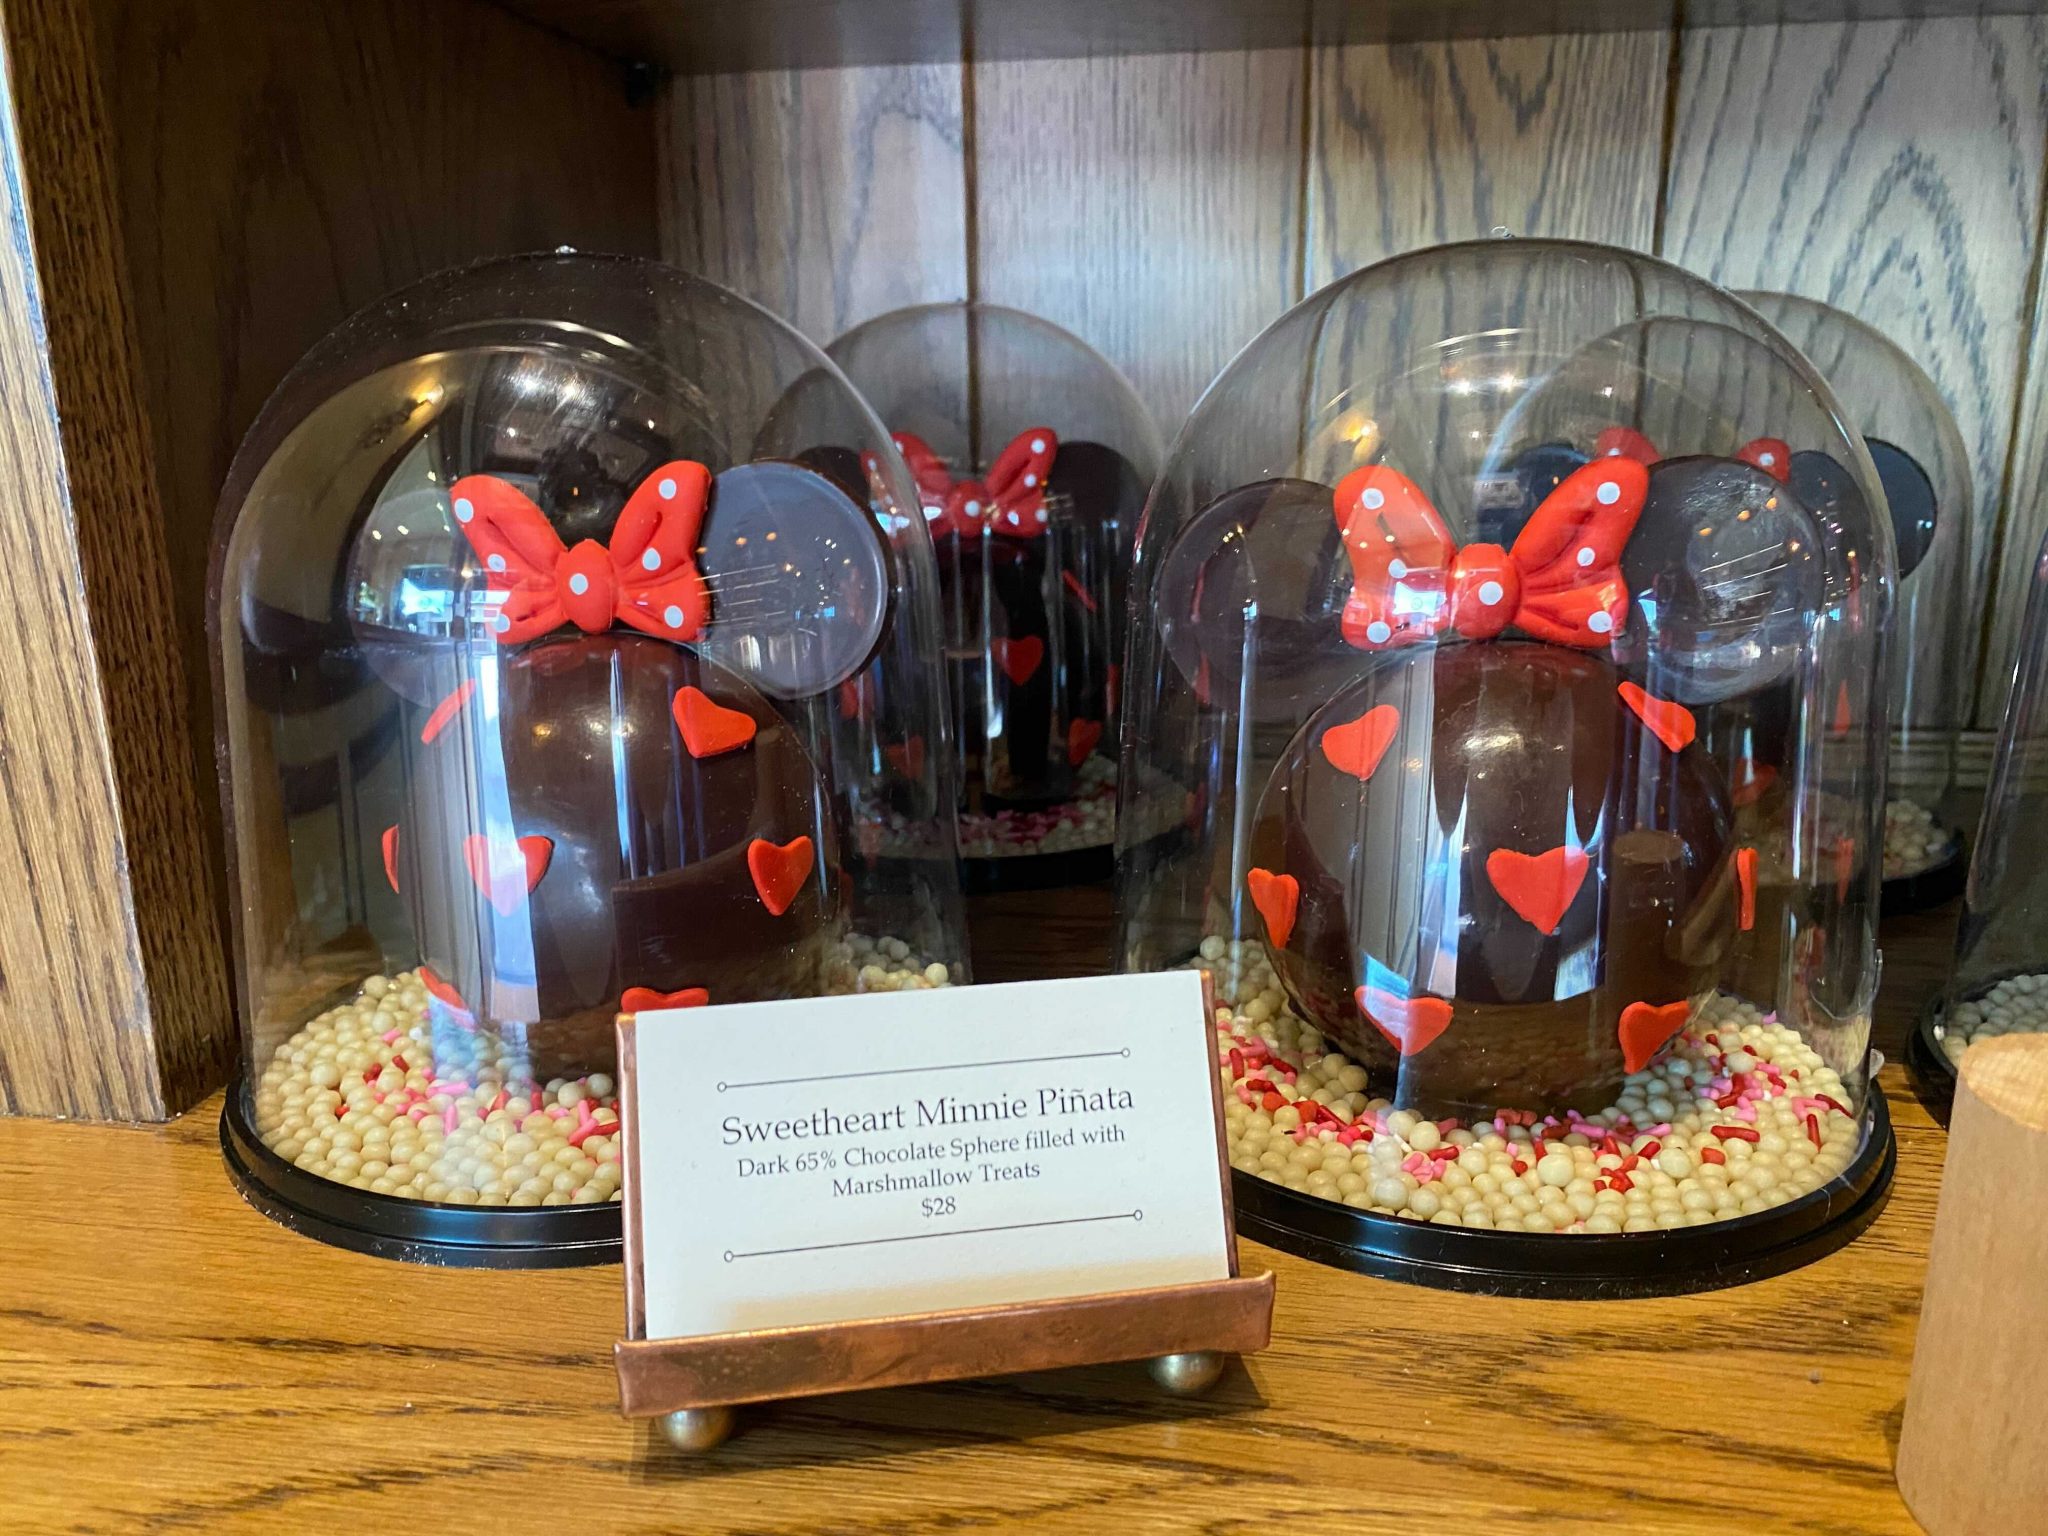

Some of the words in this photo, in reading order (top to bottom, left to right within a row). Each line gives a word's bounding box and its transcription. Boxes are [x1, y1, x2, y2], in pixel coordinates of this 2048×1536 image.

[721, 1104, 906, 1146] Sweetheart
[914, 1092, 1028, 1128] Minnie
[1036, 1087, 1135, 1117] Piñata
[737, 1154, 790, 1178] Dark
[795, 1150, 837, 1172] 65%
[843, 1141, 946, 1168] Chocolate
[950, 1135, 1020, 1163] Sphere
[1025, 1127, 1075, 1151] filled
[1080, 1123, 1126, 1144] with
[833, 1167, 973, 1198] Marshmallow
[977, 1161, 1041, 1183] Treats
[921, 1195, 957, 1219] $28
